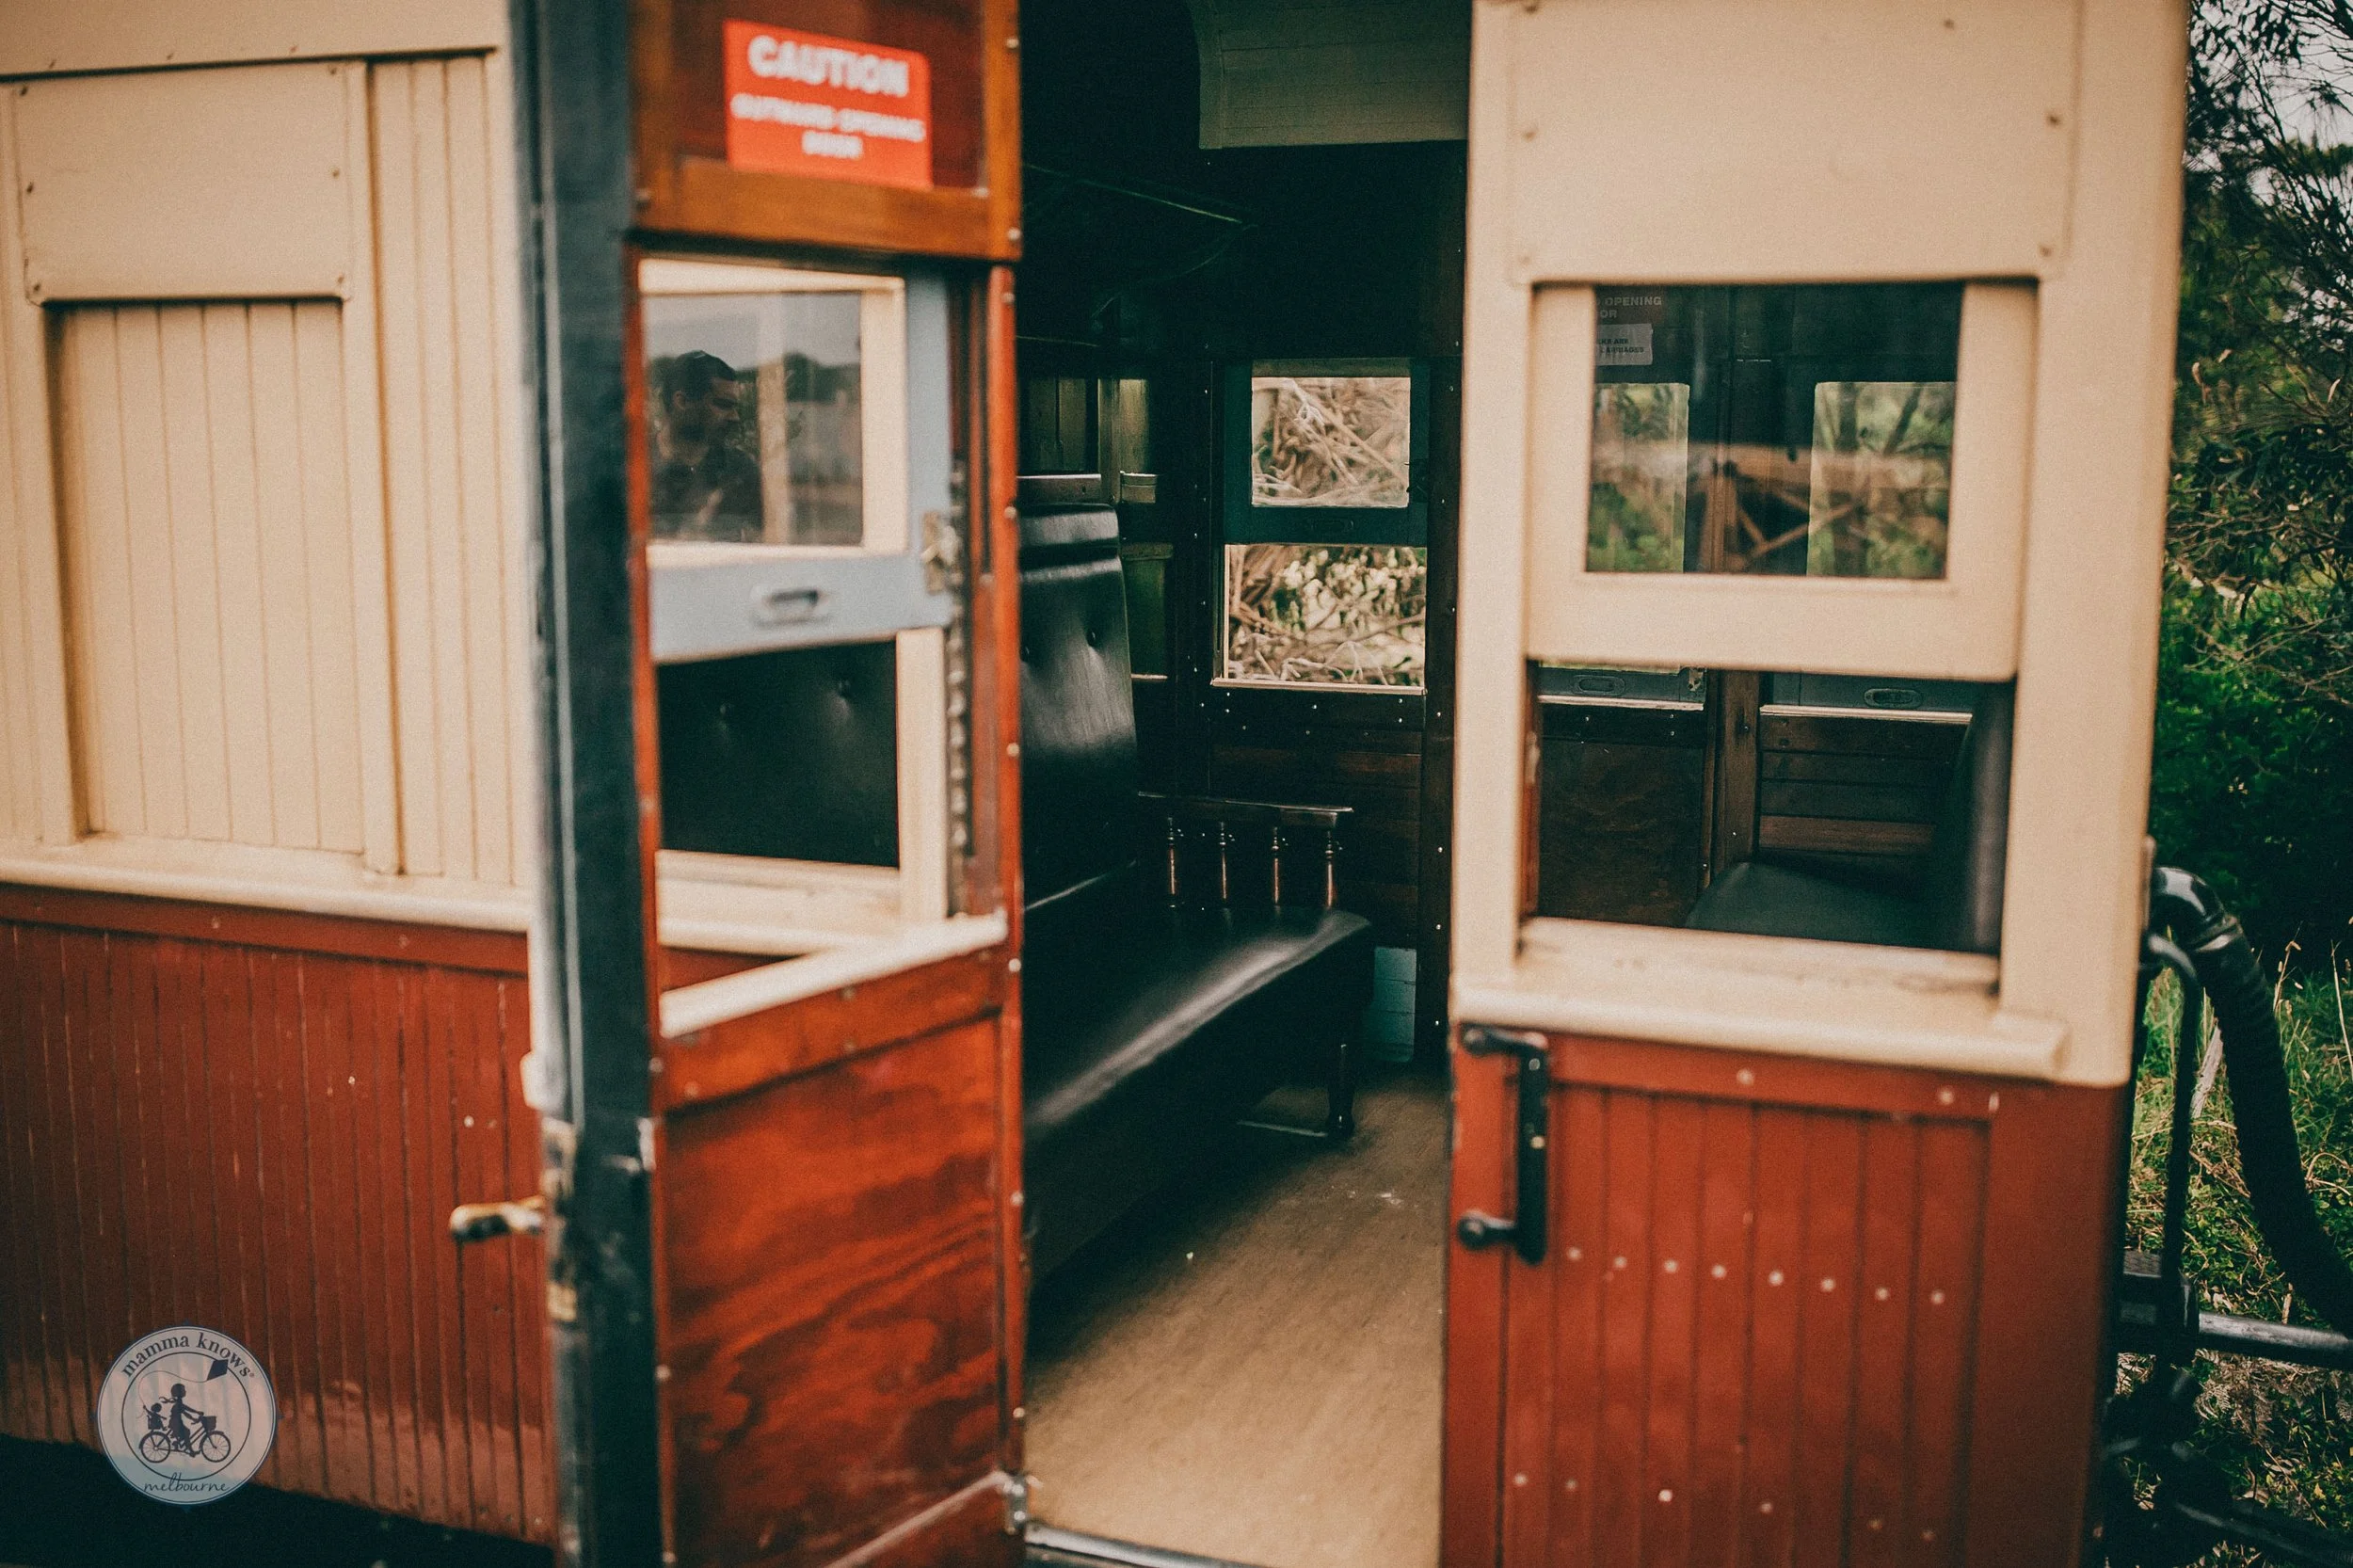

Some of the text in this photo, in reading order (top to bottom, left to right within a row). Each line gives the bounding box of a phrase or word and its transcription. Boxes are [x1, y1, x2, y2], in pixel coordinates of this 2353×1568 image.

[747, 34, 909, 98] CAUTION
[1604, 296, 1662, 306] OPENING
[1599, 309, 1617, 318] OR
